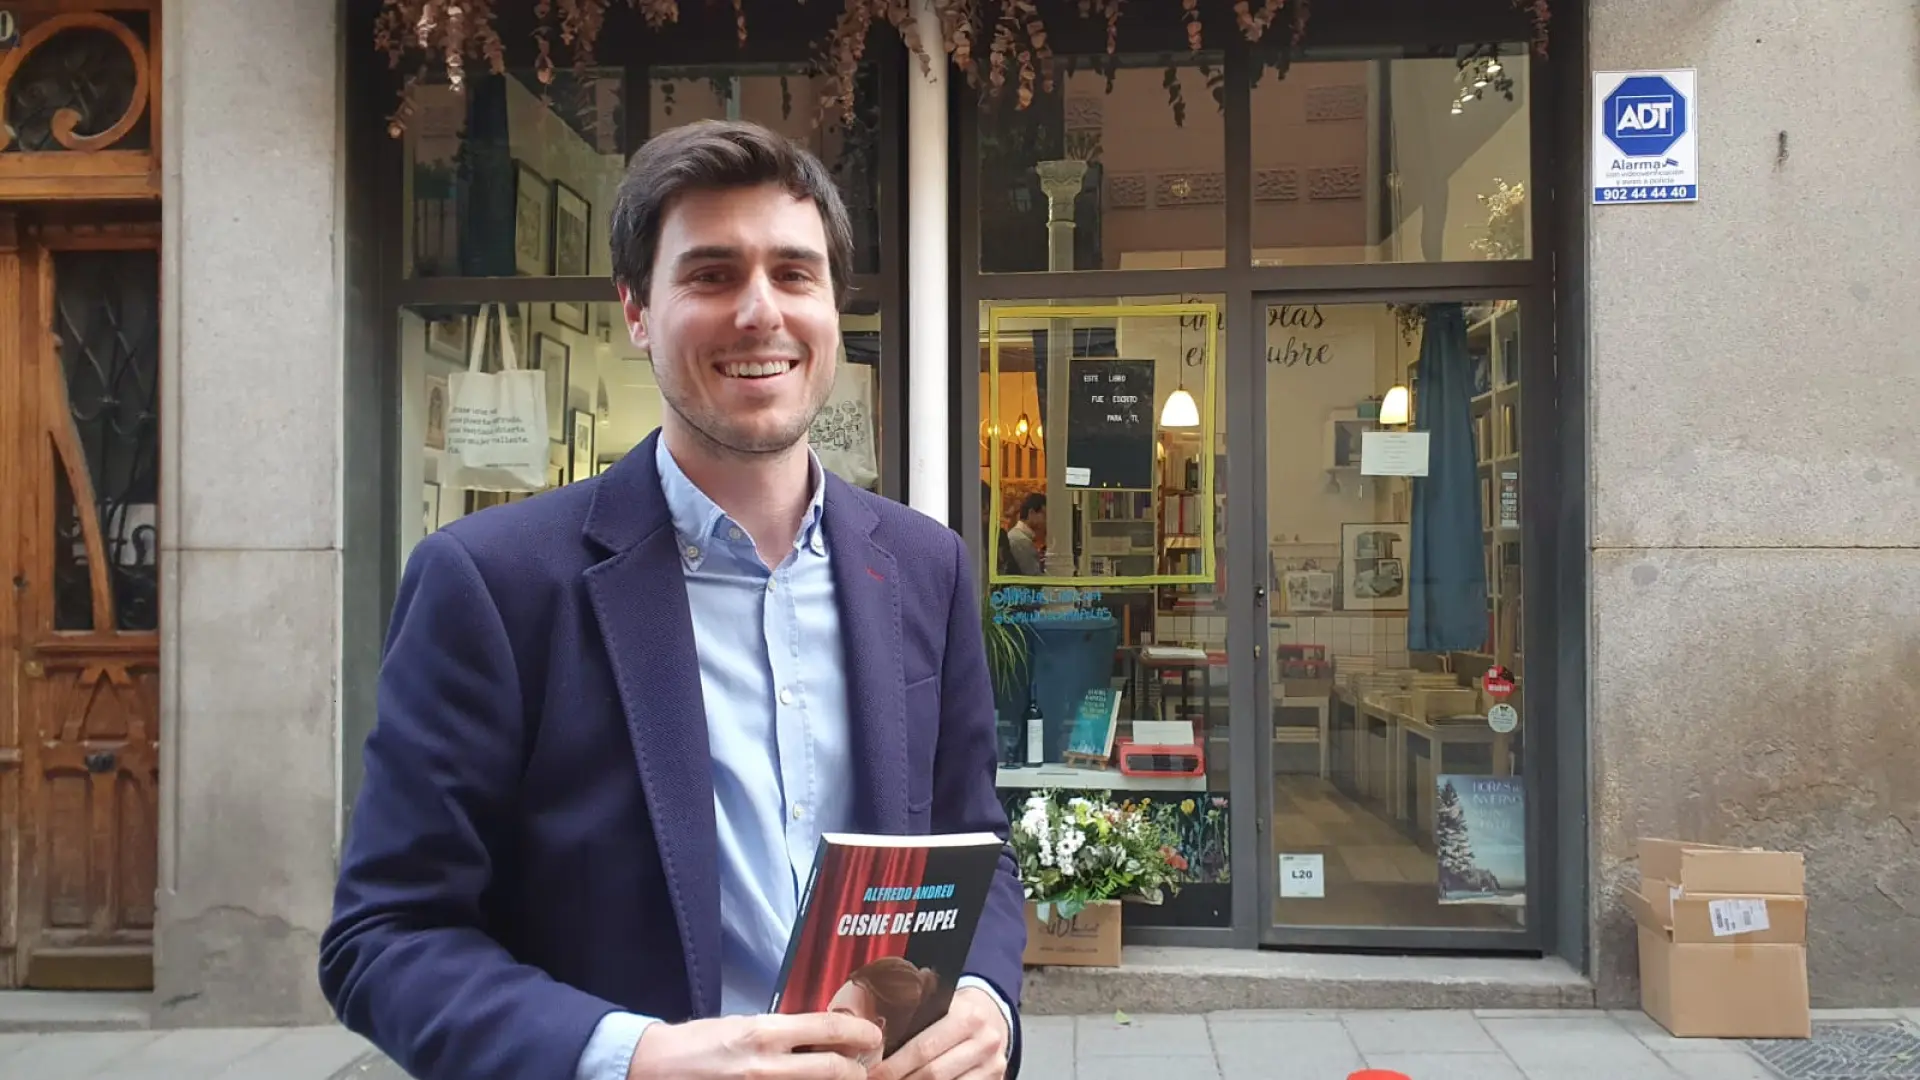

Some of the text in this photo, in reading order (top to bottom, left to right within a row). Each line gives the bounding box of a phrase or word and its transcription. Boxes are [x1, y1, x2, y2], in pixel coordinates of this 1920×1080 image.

[1617, 102, 1673, 131] ADT
[1611, 159, 1661, 170] Alarma
[1603, 186, 1687, 200] 902 44 44 40
[1084, 374, 1126, 383] ESTE LIBRO
[1092, 395, 1104, 403] FUE
[1107, 414, 1122, 423] PARA
[1291, 869, 1313, 879] L20
[863, 883, 955, 901] ALFREDO ANDREU
[837, 908, 958, 936] CISNE DE PAPEL
